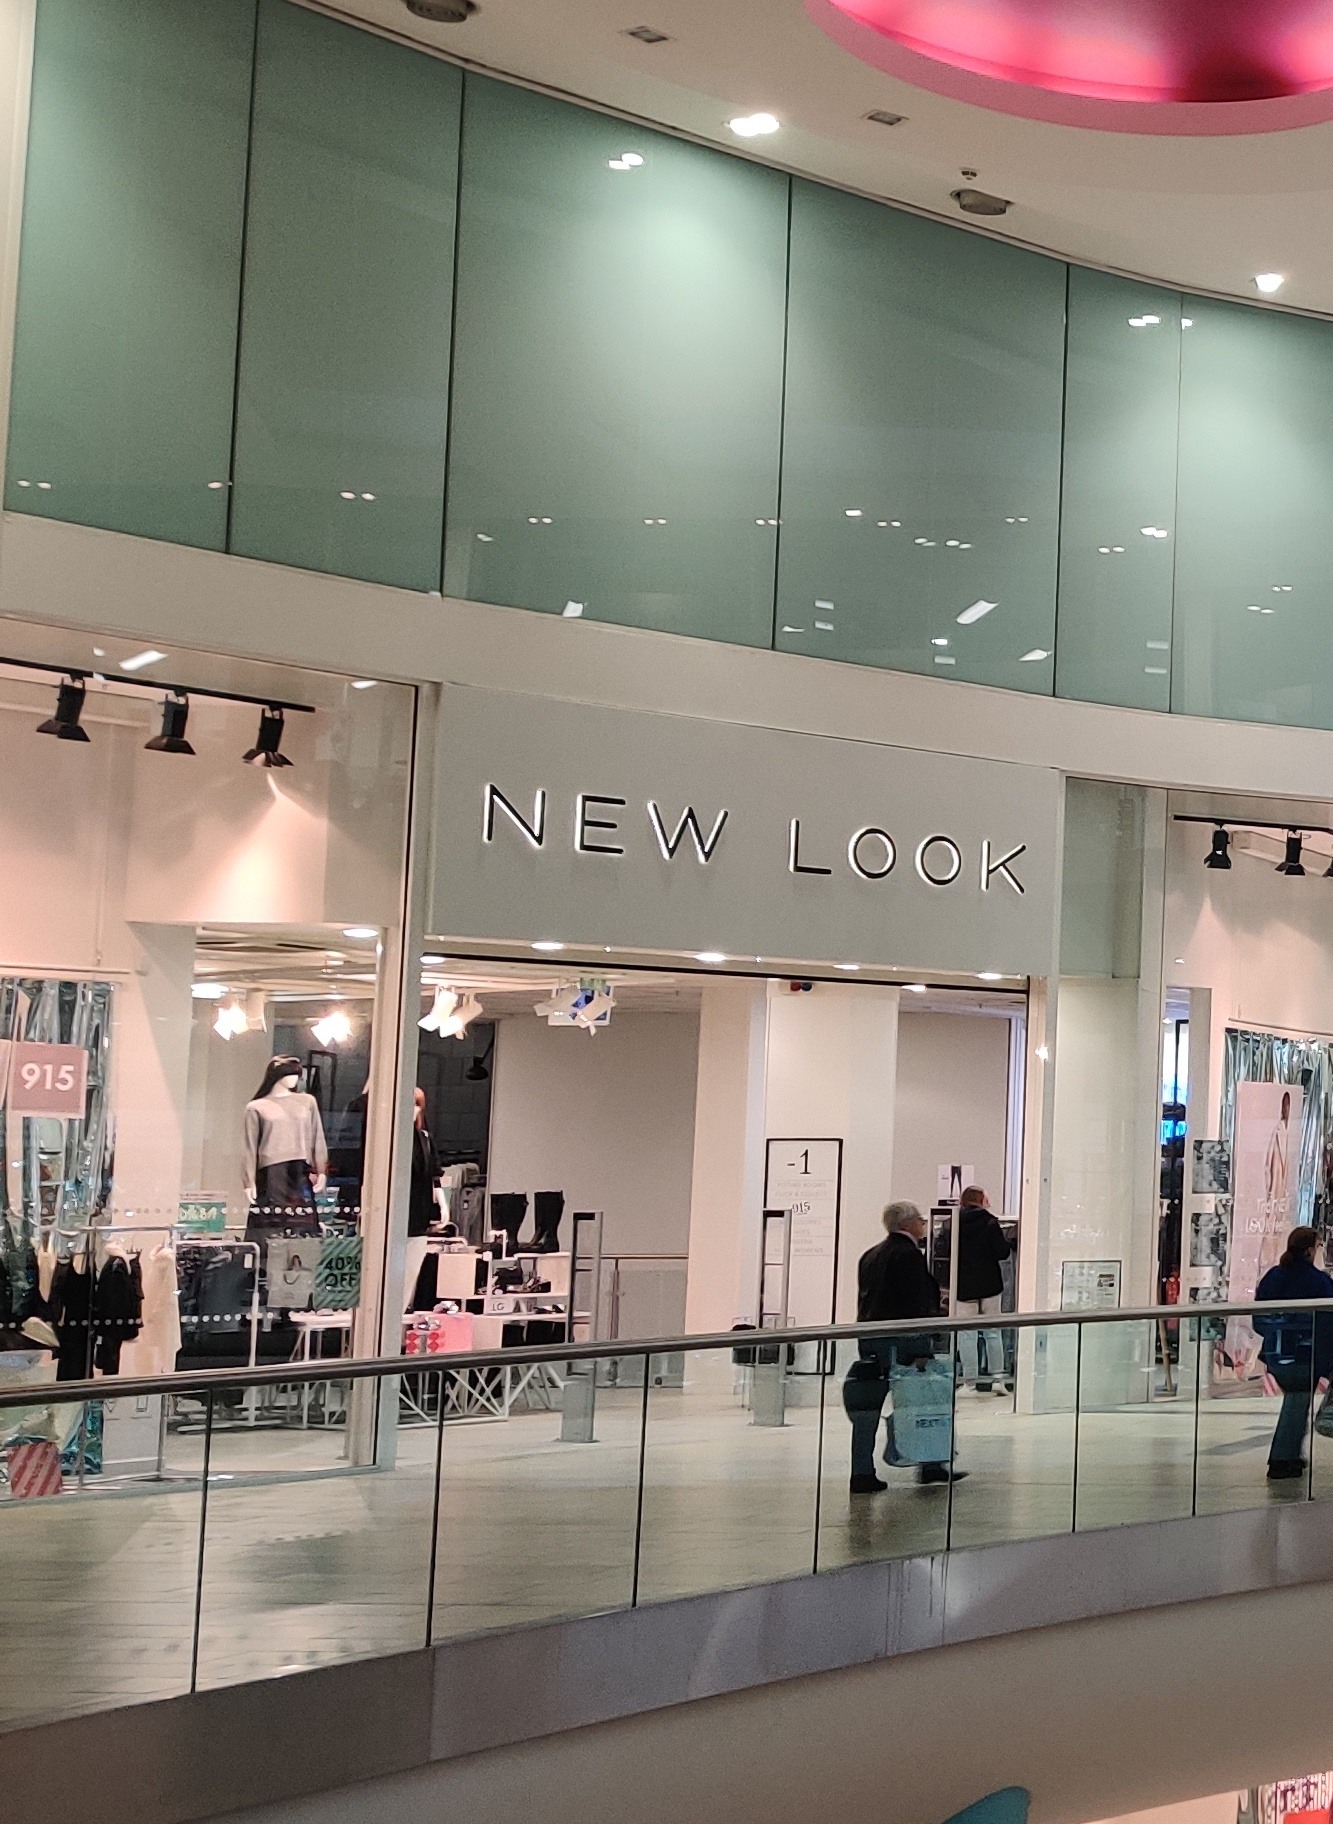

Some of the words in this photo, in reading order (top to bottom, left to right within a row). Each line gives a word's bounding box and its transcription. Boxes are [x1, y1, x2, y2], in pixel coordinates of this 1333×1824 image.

[481, 782, 729, 864] NEW
[788, 817, 1027, 895] LOOK
[21, 1062, 76, 1092] 915
[787, 1148, 812, 1175] -1
